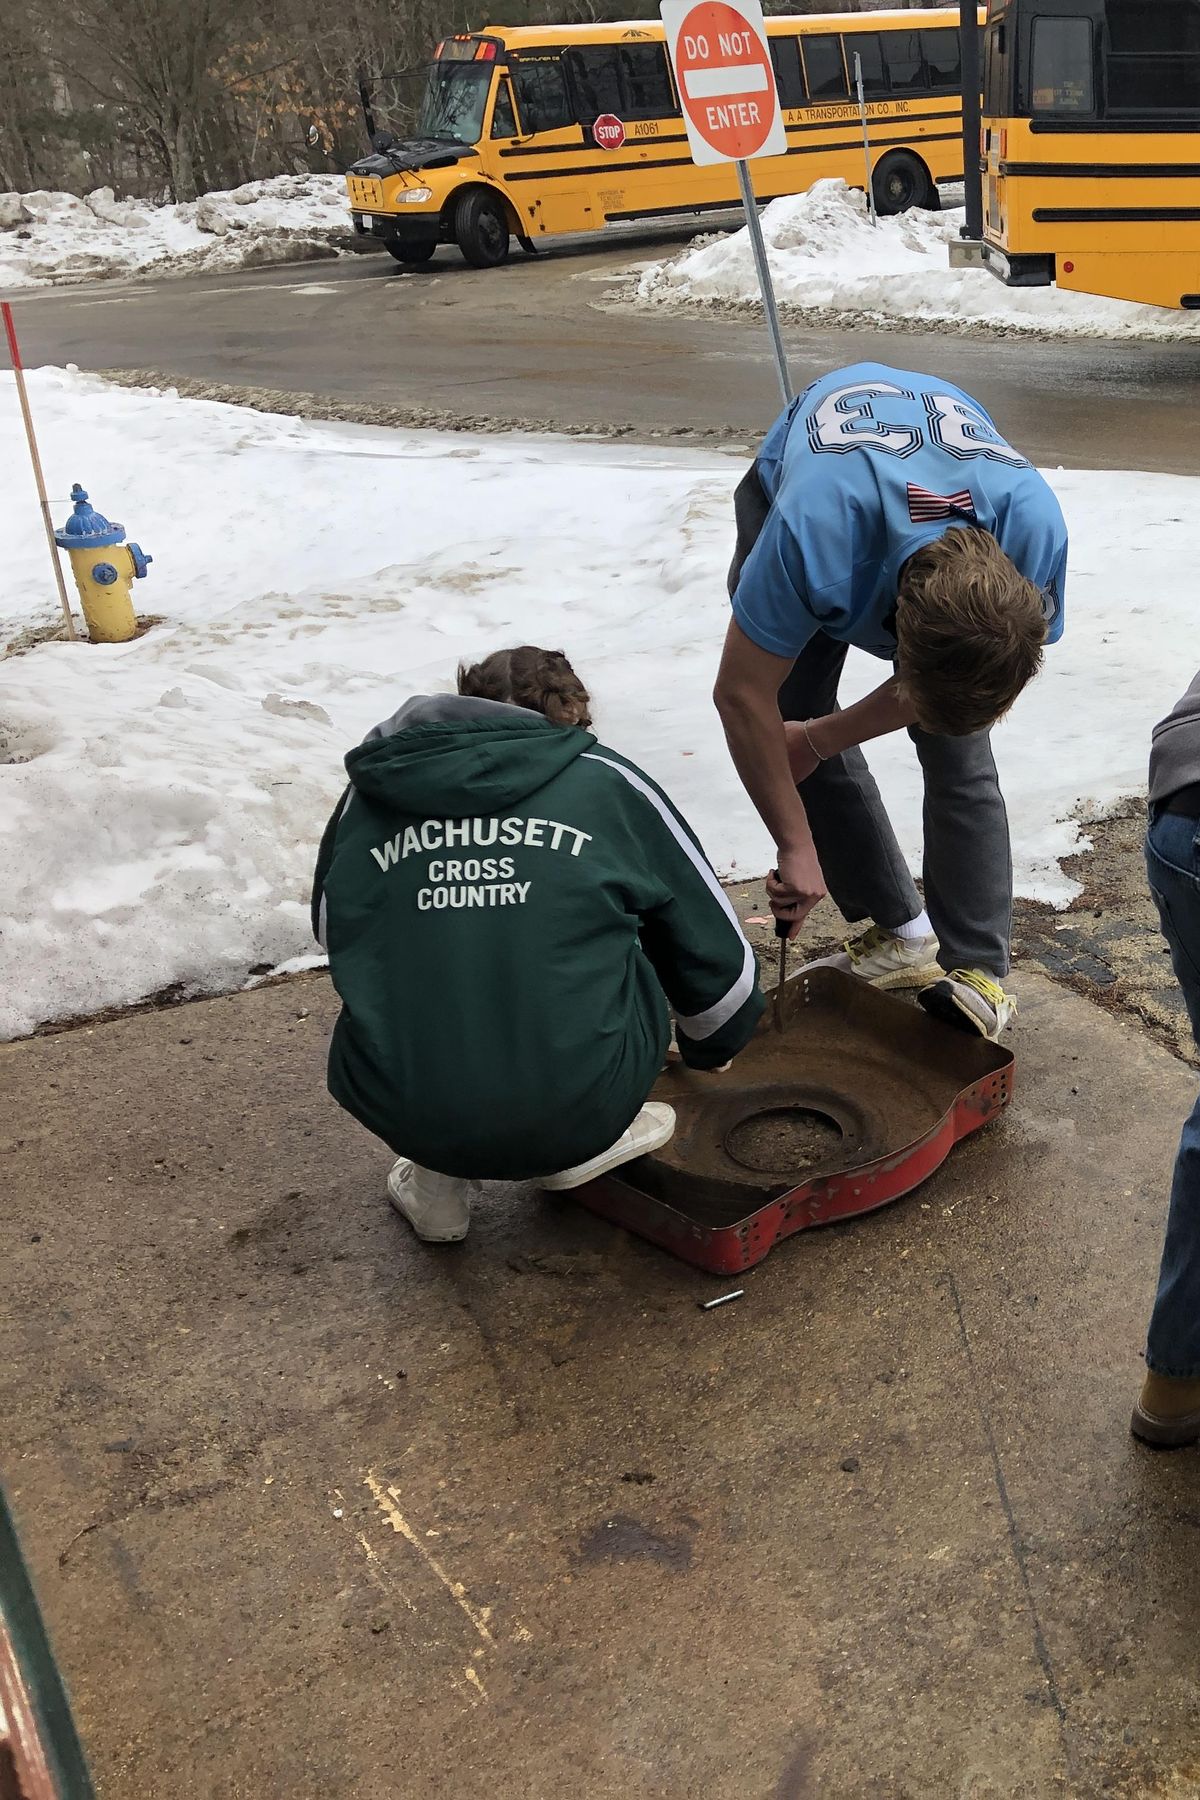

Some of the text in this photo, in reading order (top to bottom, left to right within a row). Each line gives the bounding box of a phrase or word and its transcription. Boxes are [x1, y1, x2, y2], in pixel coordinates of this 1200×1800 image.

[684, 31, 750, 60] DO NOT
[706, 102, 761, 131] ENTER
[788, 111, 794, 122] A
[796, 110, 803, 121] A
[805, 104, 875, 121] TRANSPORTATON
[598, 125, 620, 139] STOP
[634, 122, 659, 136] A1061
[369, 816, 593, 873] WACHUSETT
[428, 857, 515, 882] CROSS
[417, 881, 532, 911] COUNTRY
